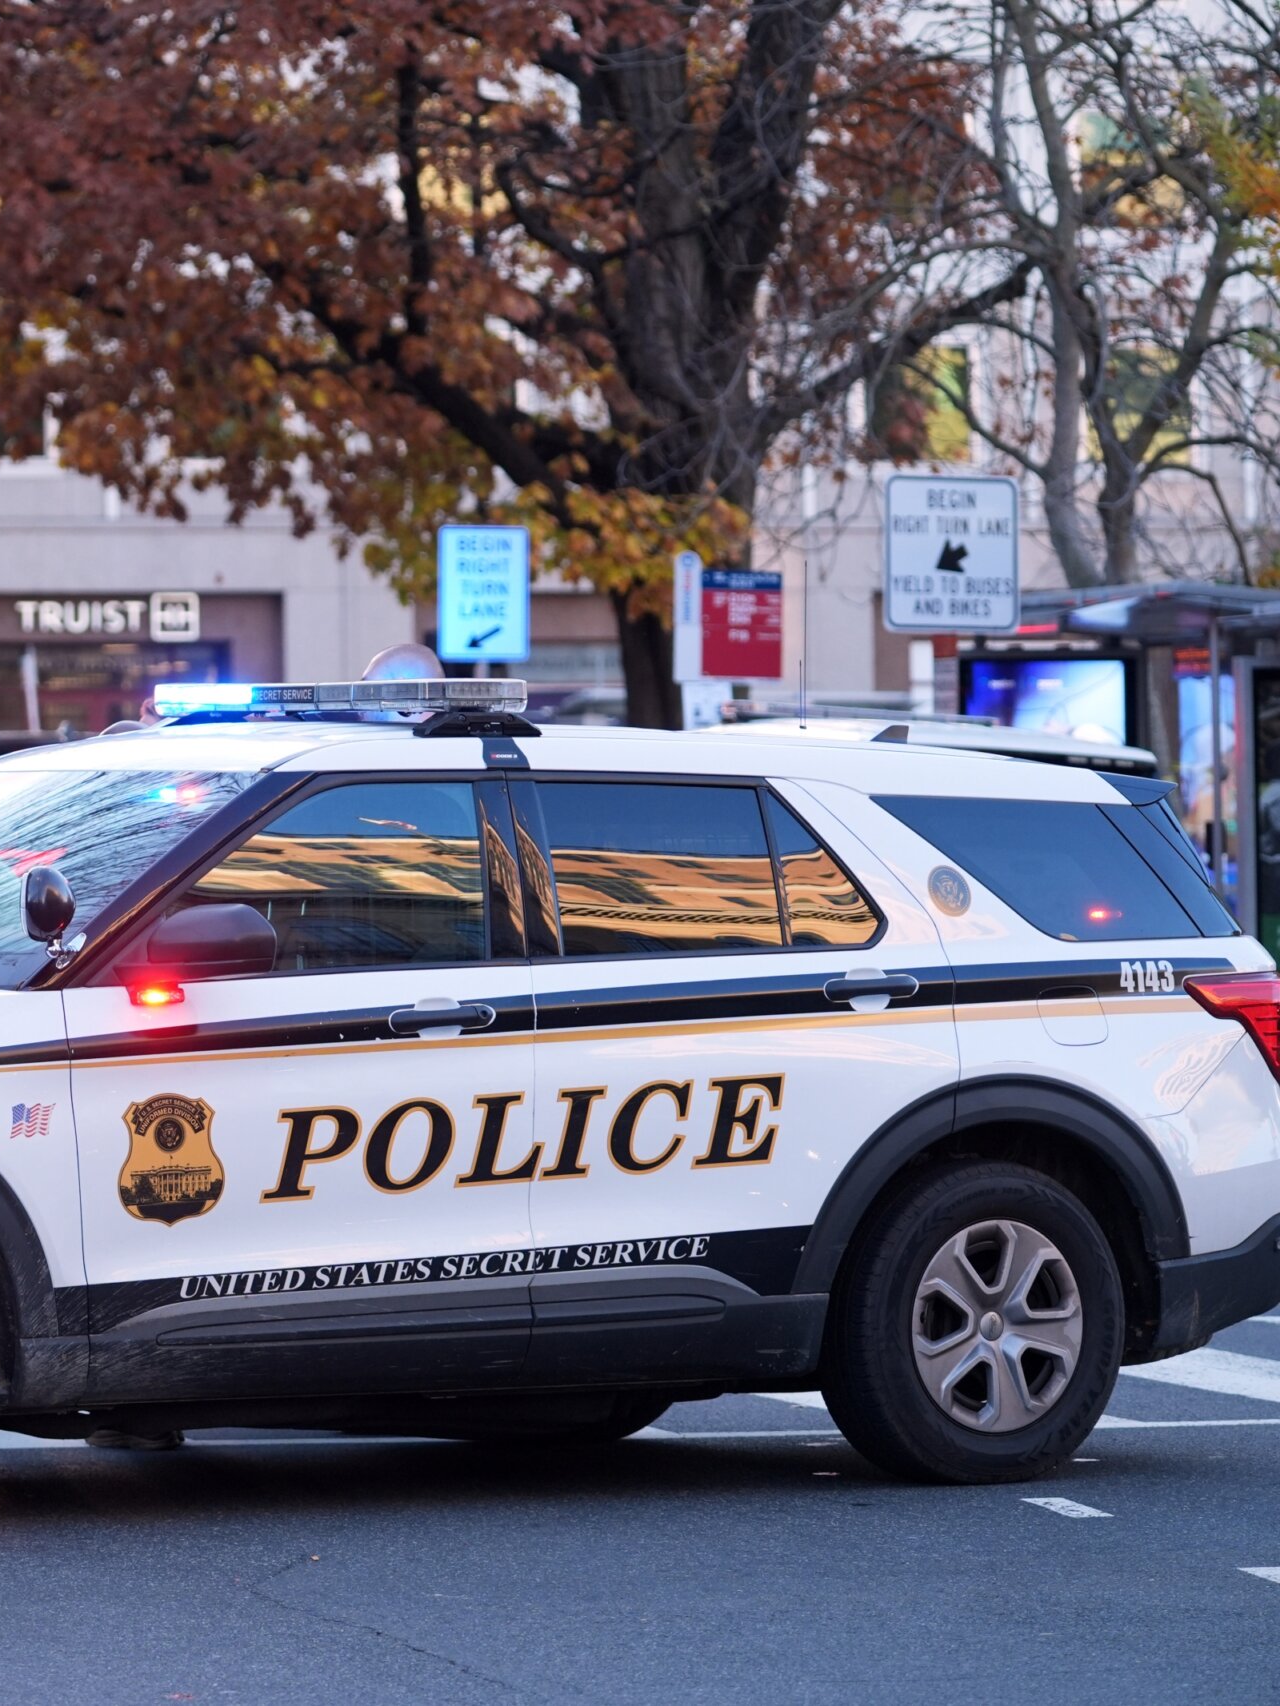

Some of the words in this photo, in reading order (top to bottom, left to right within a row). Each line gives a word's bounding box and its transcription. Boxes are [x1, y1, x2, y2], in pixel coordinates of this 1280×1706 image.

[927, 488, 976, 509] BEGIN
[893, 515, 928, 534] RIGHT
[936, 515, 969, 535] TURN
[978, 517, 1011, 536] LANE
[457, 535, 512, 552] BEGIN
[457, 558, 510, 573] RIGHT
[460, 580, 510, 596] TURN
[893, 575, 934, 593] YIELD
[941, 576, 960, 594] TO
[965, 577, 1013, 596] BUSES
[14, 599, 148, 634] TRUIST
[458, 602, 507, 618] LANE
[913, 598, 943, 616] AND
[949, 599, 991, 618] BIKES
[283, 688, 312, 700] SERVICE
[1120, 960, 1175, 992] 4143
[152, 1099, 173, 1109] SECRET
[173, 1099, 196, 1113] SERVICE
[139, 1107, 173, 1134] UNIFORMED
[174, 1107, 200, 1130] DIVISION
[259, 1072, 785, 1203] POLICE
[179, 1268, 306, 1299] UNITED
[312, 1257, 433, 1290] STATES
[439, 1247, 569, 1280] SECRET
[573, 1235, 710, 1268] SERVICE
